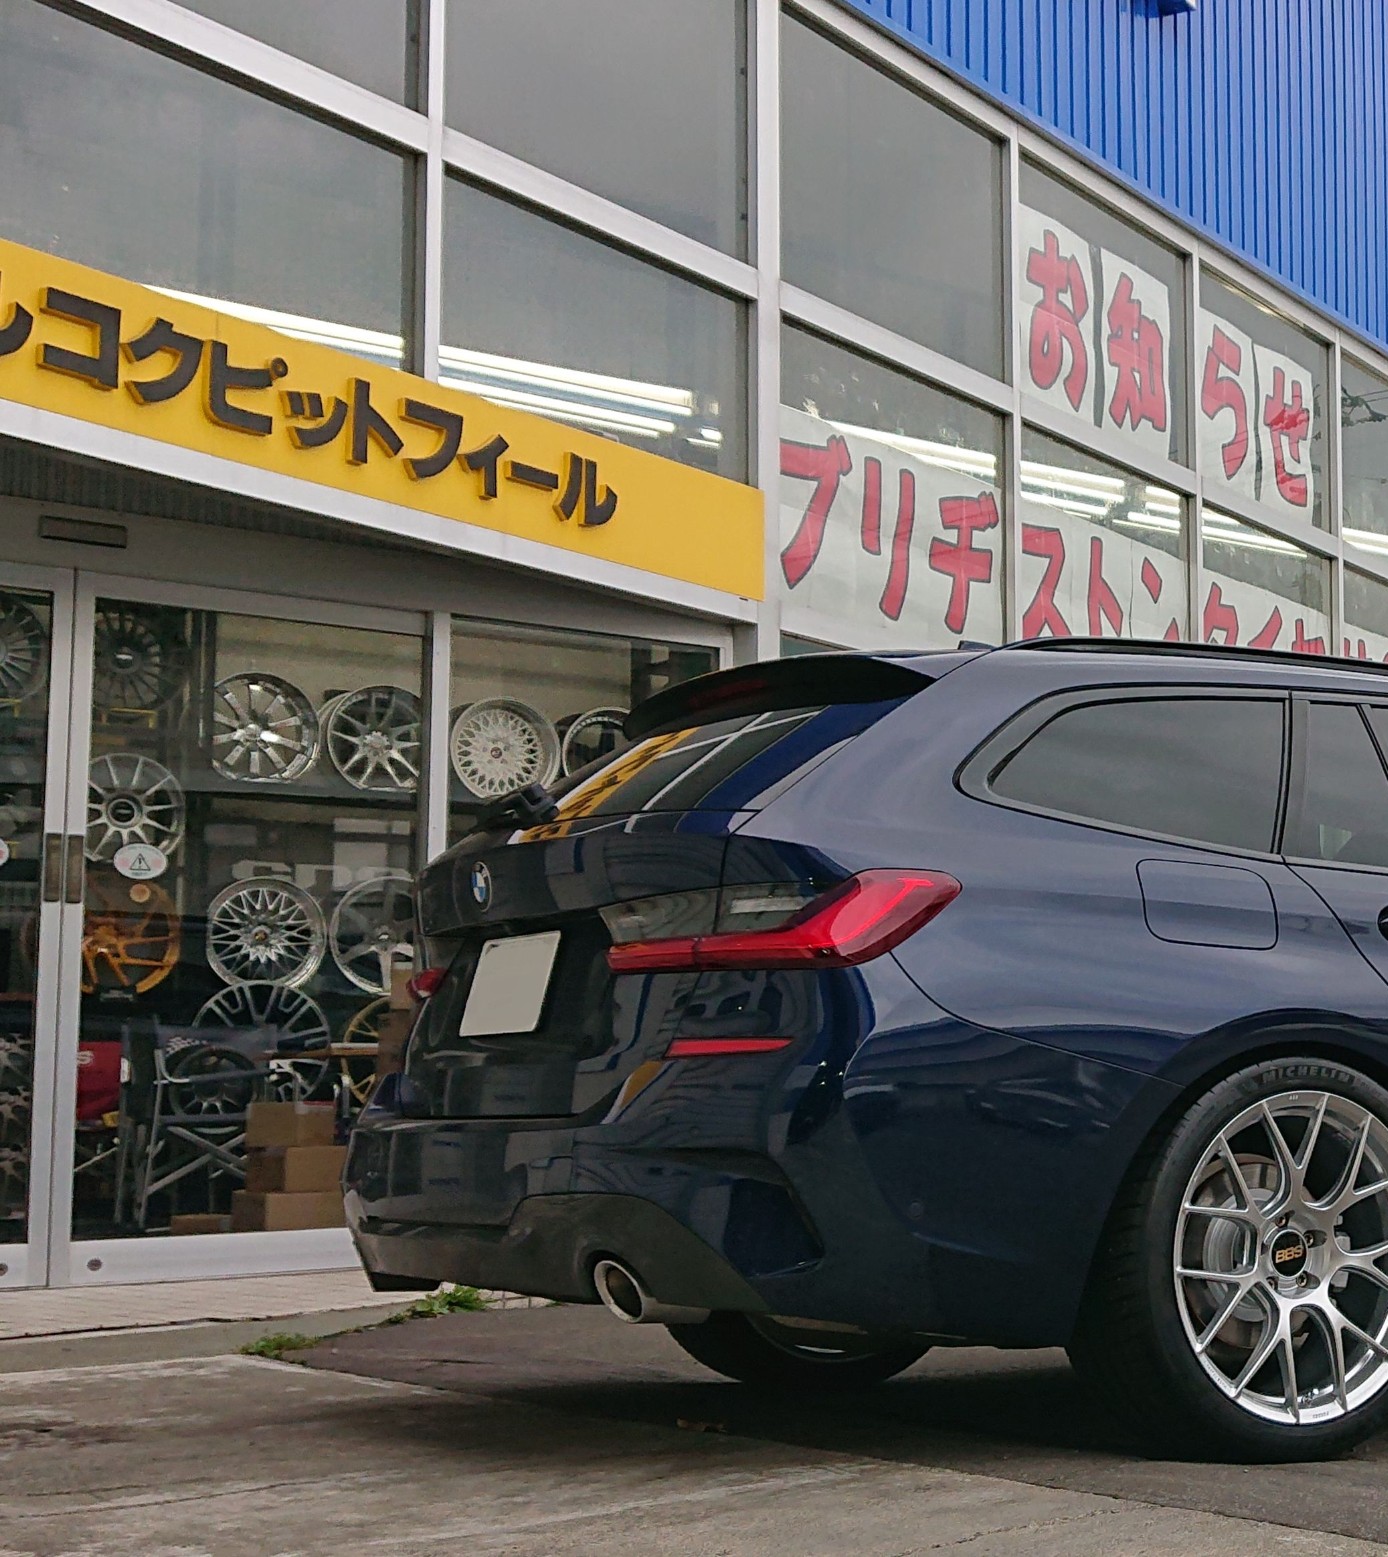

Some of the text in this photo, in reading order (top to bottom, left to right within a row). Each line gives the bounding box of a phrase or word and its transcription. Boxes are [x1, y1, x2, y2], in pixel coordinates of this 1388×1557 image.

[1025, 229, 1311, 508] お知らせ
[1262, 1065, 1351, 1083] MICHELIN
[1275, 1244, 1303, 1264] BBS
